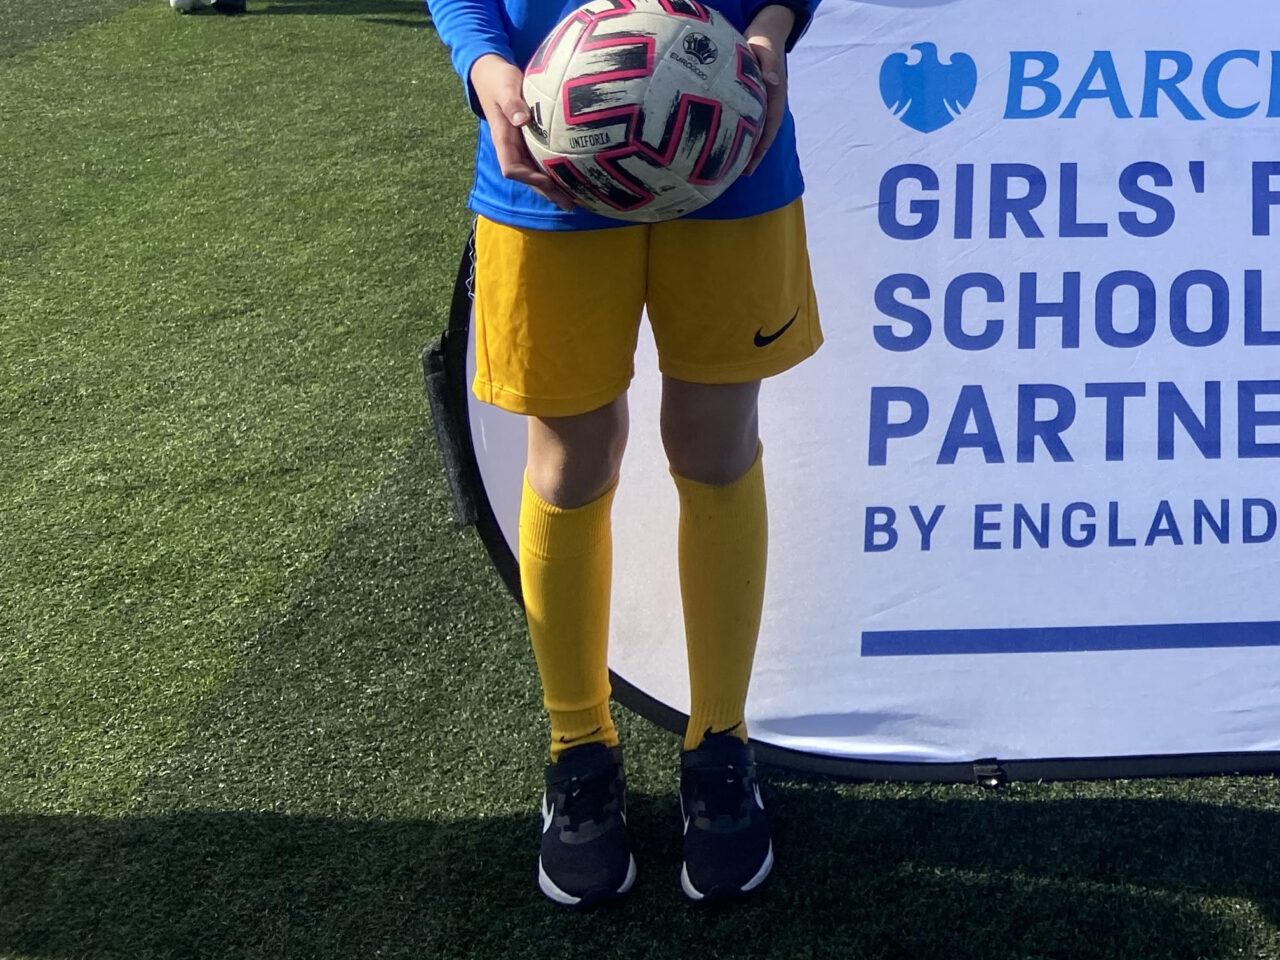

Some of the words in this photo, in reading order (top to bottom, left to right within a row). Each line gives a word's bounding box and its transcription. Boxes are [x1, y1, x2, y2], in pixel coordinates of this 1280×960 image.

[568, 132, 611, 149] UNIFORIA
[877, 160, 1205, 240] GIRLS'
[863, 504, 946, 553] BY
[973, 498, 1278, 550] ENGLAND
